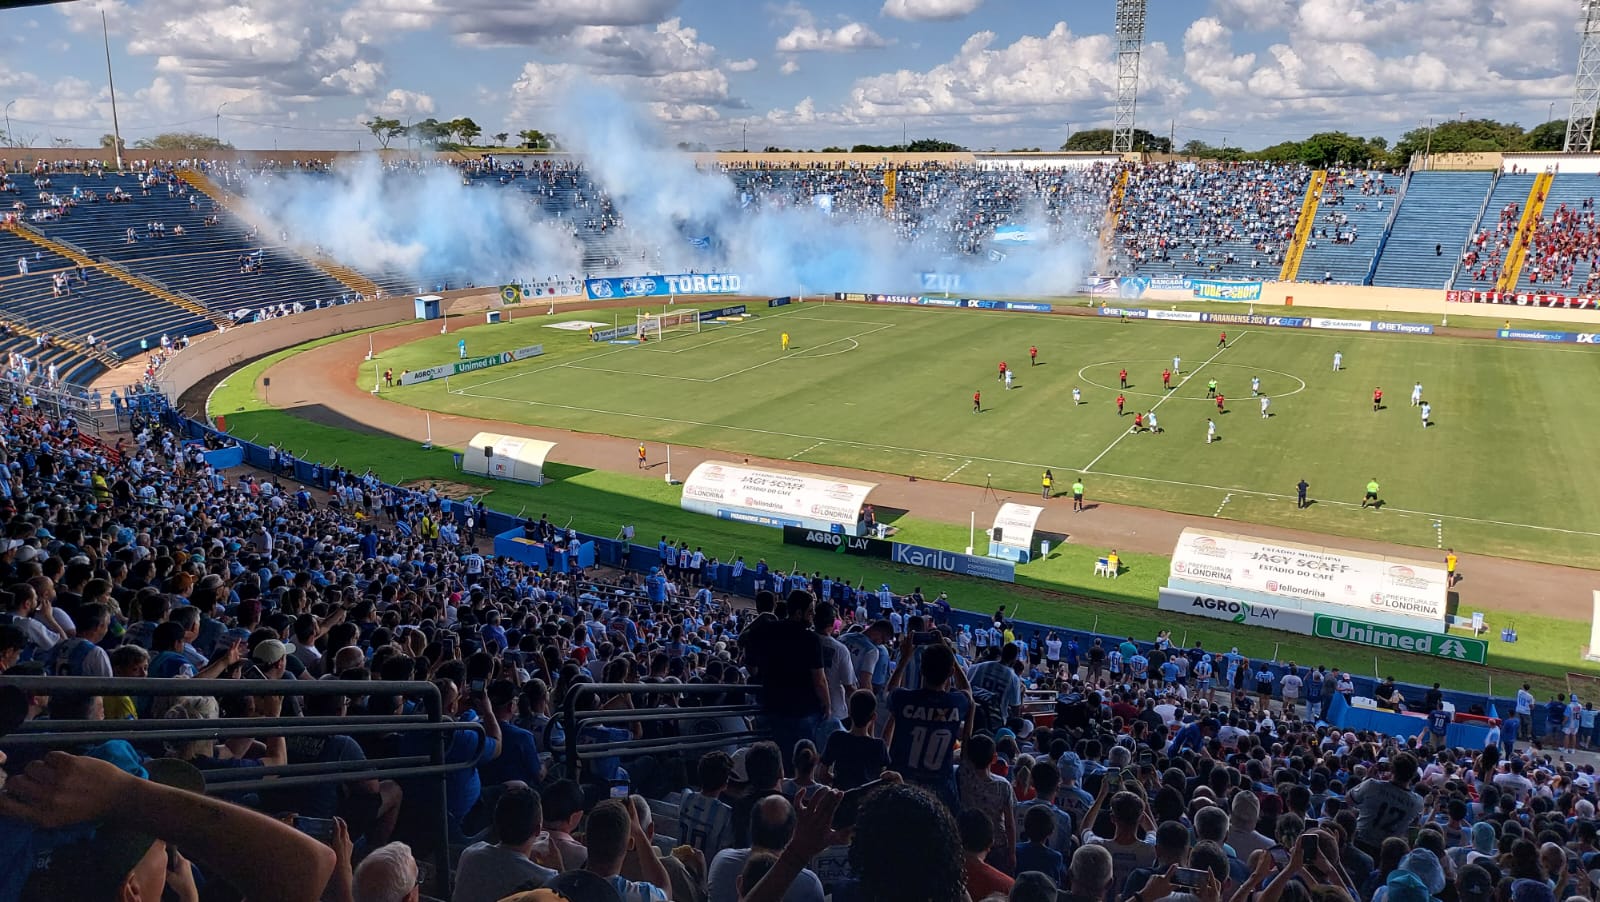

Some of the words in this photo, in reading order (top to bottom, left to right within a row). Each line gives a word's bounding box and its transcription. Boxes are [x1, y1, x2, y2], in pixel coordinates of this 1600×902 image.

[663, 274, 742, 294] TORCID
[967, 300, 997, 308] 1XBET
[1209, 314, 1250, 324] PARANAENSE
[1251, 316, 1267, 325] 2024
[1268, 317, 1302, 327] 1XBET
[459, 359, 488, 372] Unimed
[694, 489, 724, 500] LONDRINA
[820, 509, 853, 520] LONDRINA
[898, 545, 956, 571] Karilu
[1296, 558, 1351, 574] SCAFF
[1187, 567, 1232, 581] LONDRINA
[1297, 569, 1310, 577] DO
[1385, 600, 1438, 615] LONDRINA
[1330, 620, 1432, 654] Unimed
[902, 704, 960, 722] CAIXA
[1434, 717, 1445, 728] 10
[908, 725, 952, 772] 10
